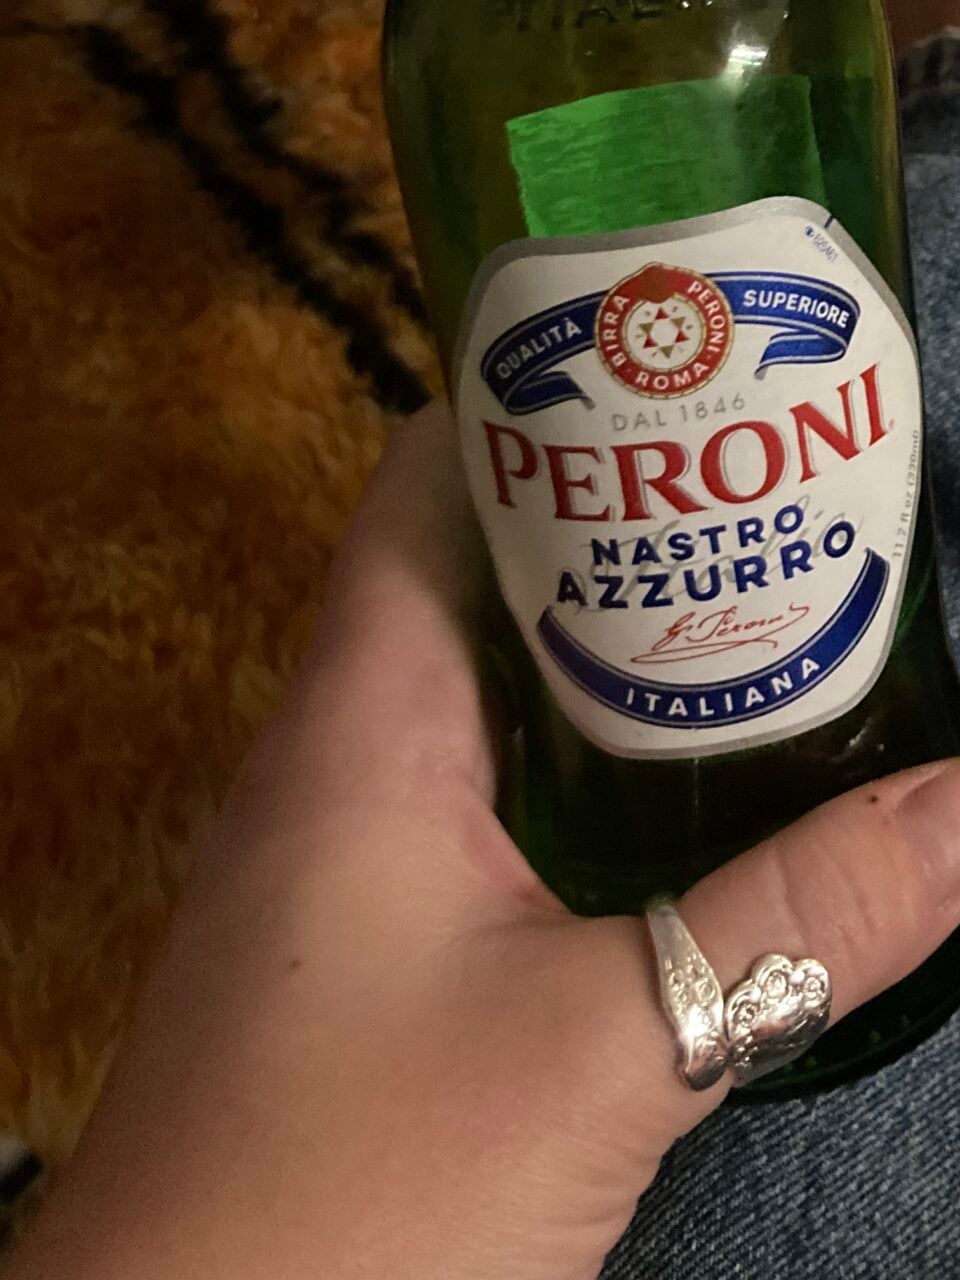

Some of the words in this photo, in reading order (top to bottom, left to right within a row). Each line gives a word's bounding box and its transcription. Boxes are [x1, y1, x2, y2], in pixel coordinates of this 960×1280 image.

[498, 316, 583, 379] QUALITÀ
[742, 289, 850, 328] SUPERIORE
[602, 293, 631, 368] BIRRA
[687, 279, 727, 354] PERONI
[612, 409, 668, 431] DAL
[679, 394, 746, 422] 1846
[635, 361, 710, 391] ROMA
[482, 361, 892, 523] PERONI
[556, 521, 856, 609] AZZURRO
[591, 504, 804, 566] NASTRO
[626, 657, 821, 717] ITALIANA
